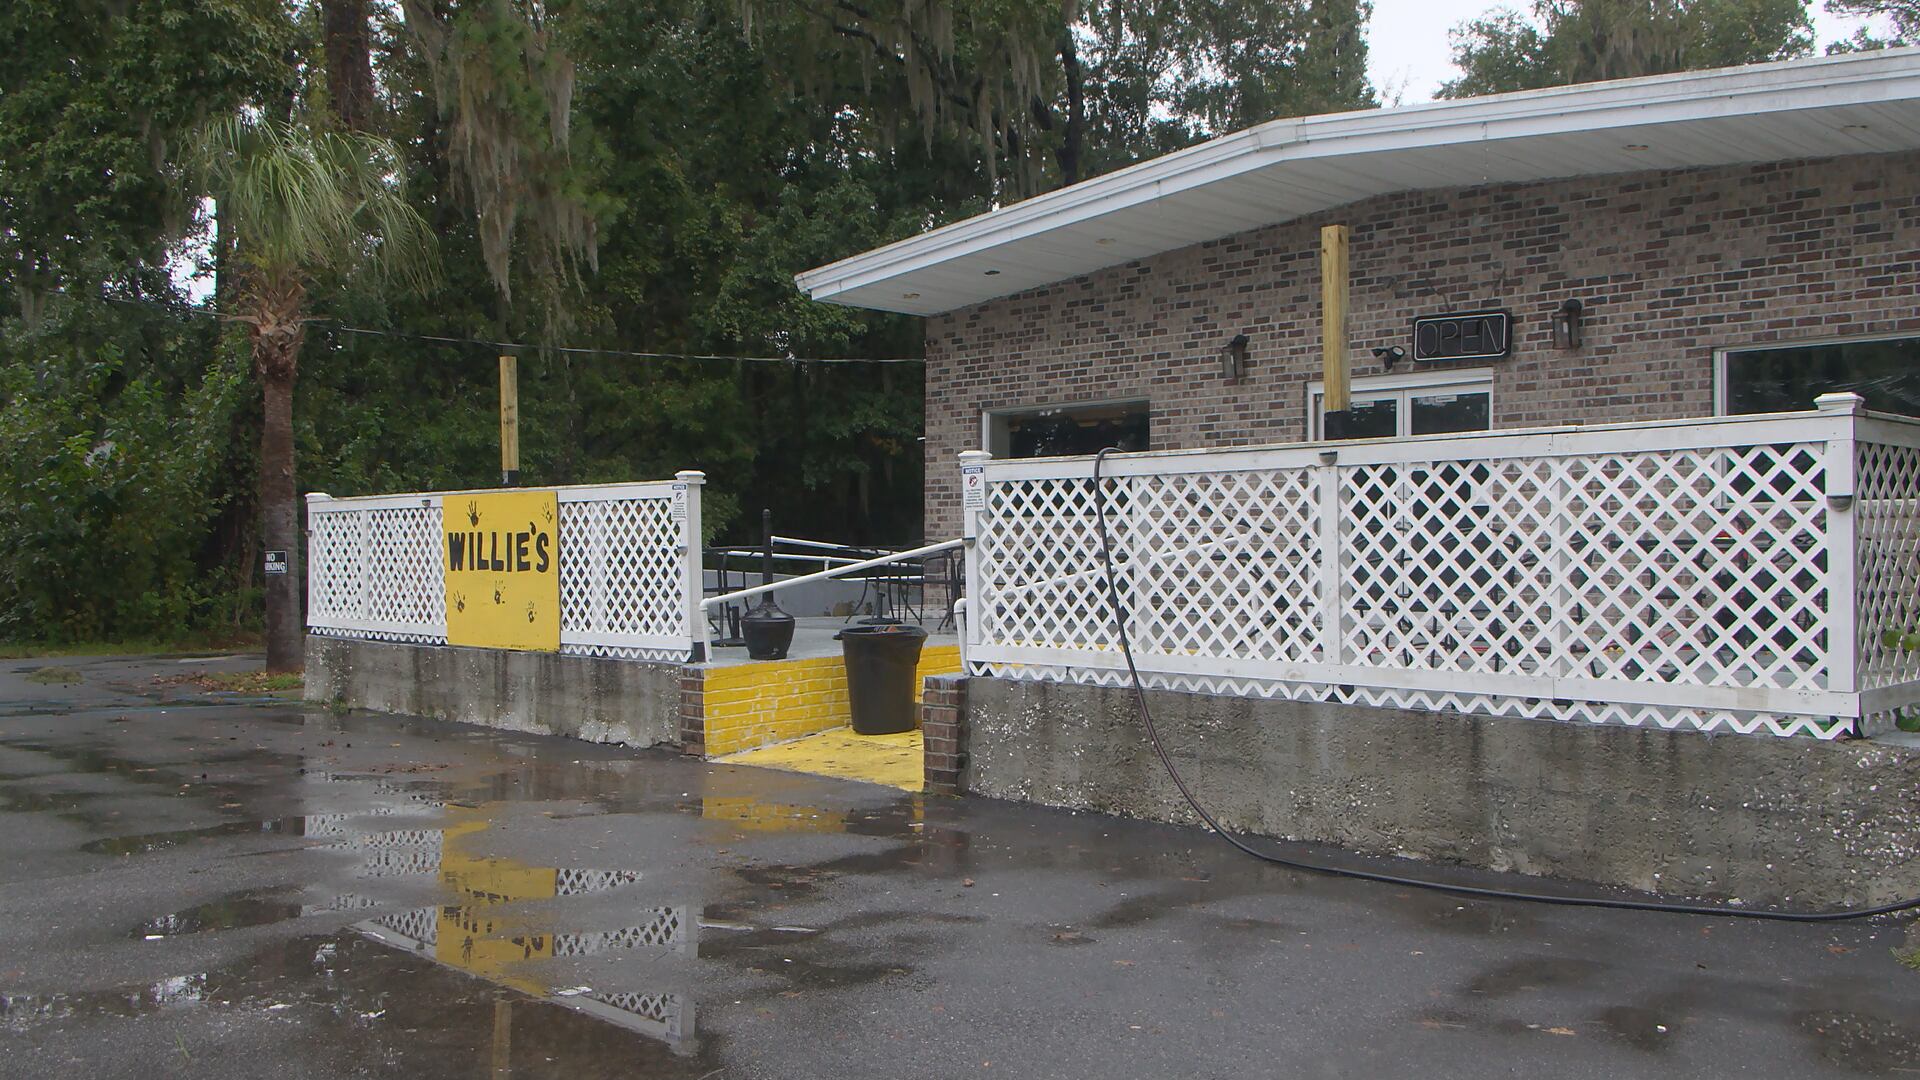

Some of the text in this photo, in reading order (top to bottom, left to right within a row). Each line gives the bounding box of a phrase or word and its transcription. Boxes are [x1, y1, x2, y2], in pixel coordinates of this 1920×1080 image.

[1419, 319, 1503, 356] OPEN
[266, 553, 276, 562] NO
[448, 521, 549, 573] WILLIE'S
